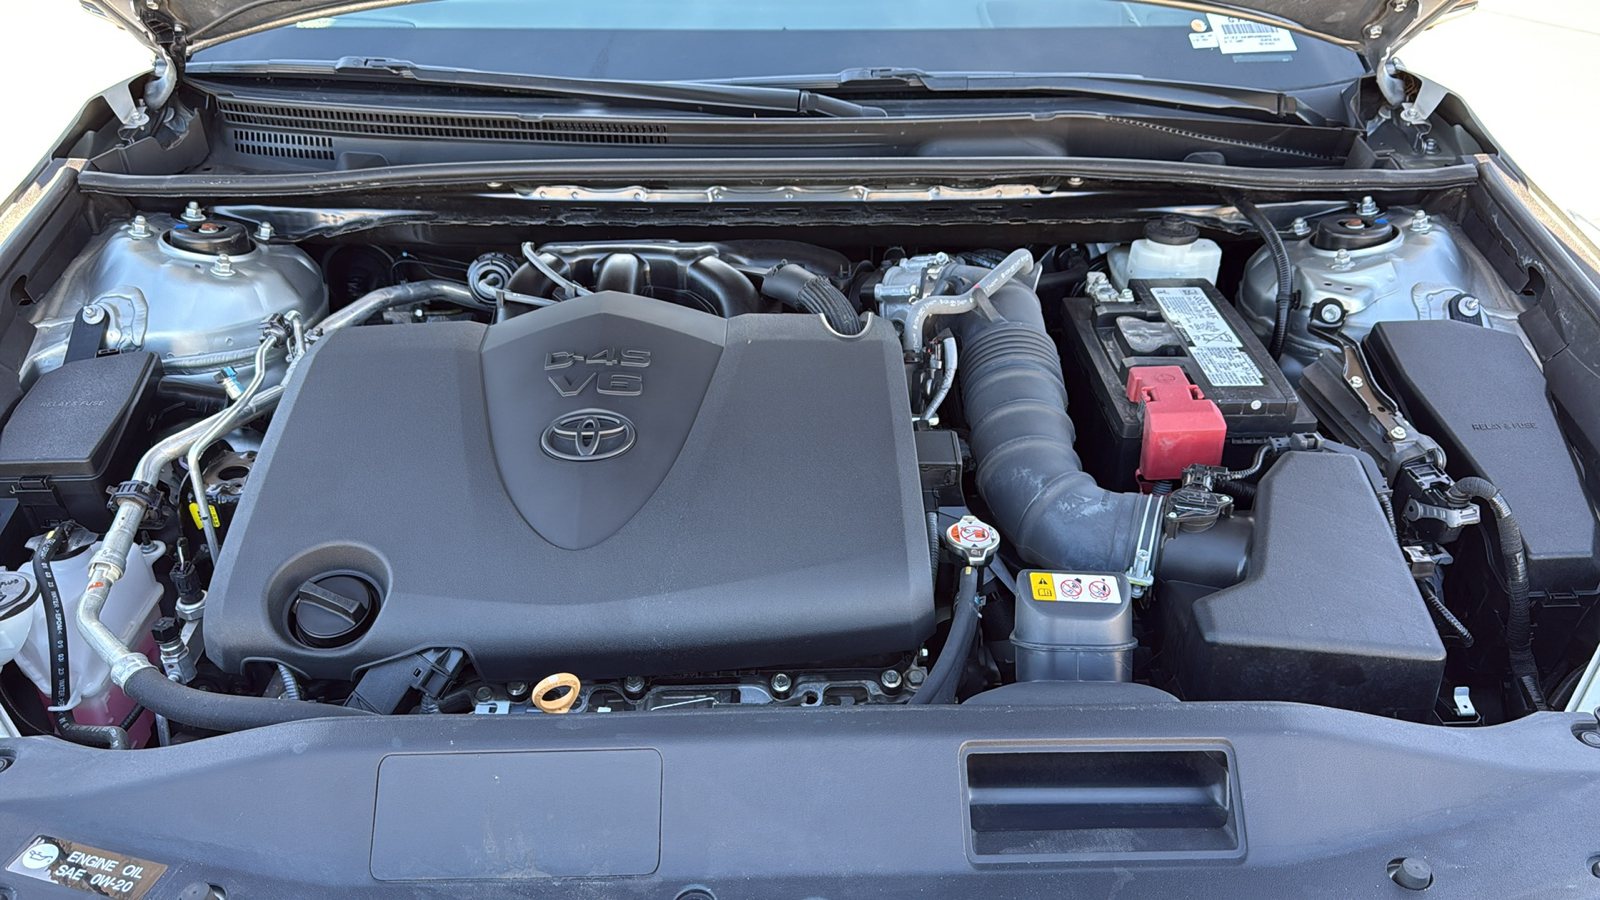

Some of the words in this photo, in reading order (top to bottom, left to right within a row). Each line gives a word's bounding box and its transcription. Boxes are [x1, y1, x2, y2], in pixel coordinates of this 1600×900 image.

[544, 346, 651, 371] D-4S
[547, 371, 643, 397] V6
[1471, 422, 1502, 431] RELAY
[66, 851, 119, 872] ENGINE
[121, 865, 144, 879] OIL
[55, 865, 86, 881] SAE
[90, 873, 133, 893] 0W-20
